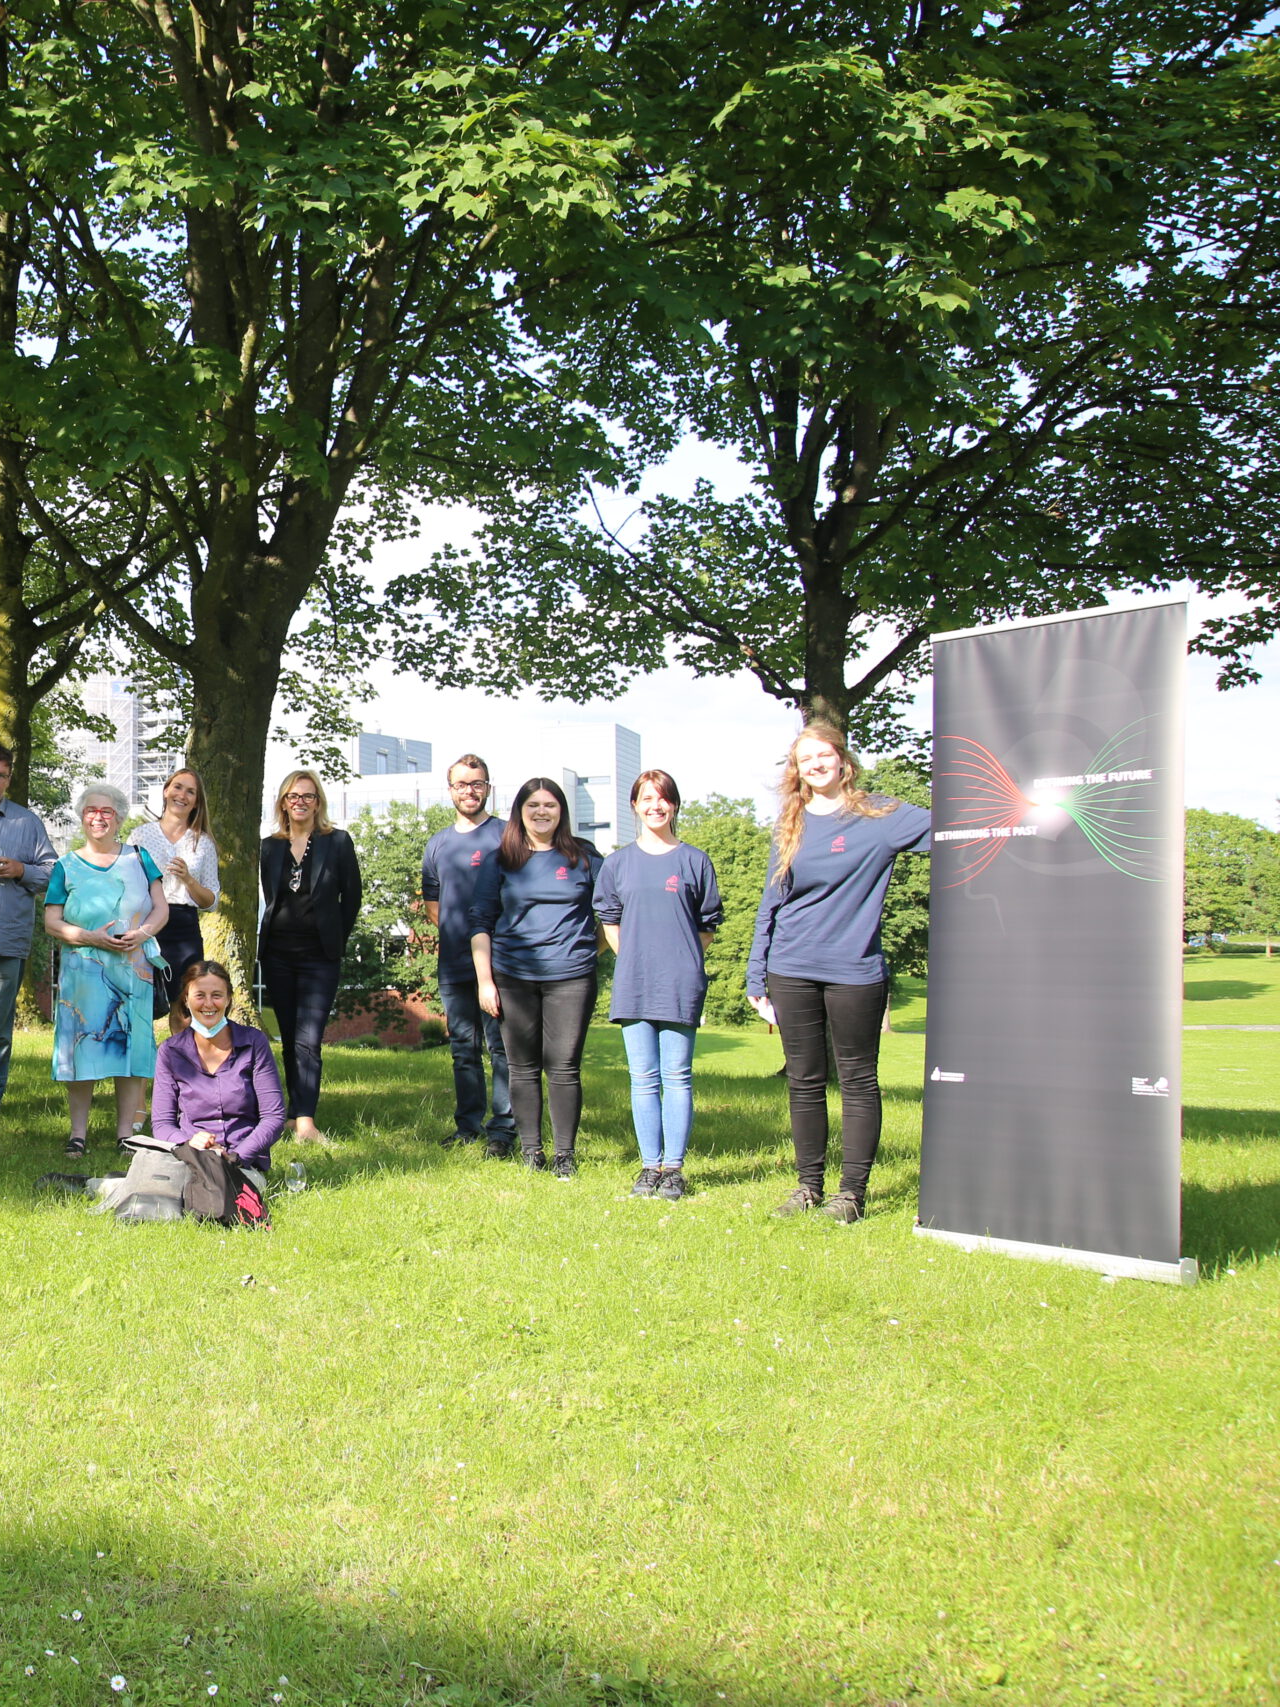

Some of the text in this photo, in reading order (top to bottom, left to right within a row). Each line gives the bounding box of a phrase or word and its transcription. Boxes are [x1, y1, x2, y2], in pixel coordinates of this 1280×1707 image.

[1085, 773, 1107, 784] THE
[1108, 769, 1152, 783] FUTURE
[934, 825, 1039, 842] RETHINKING THE PAST
